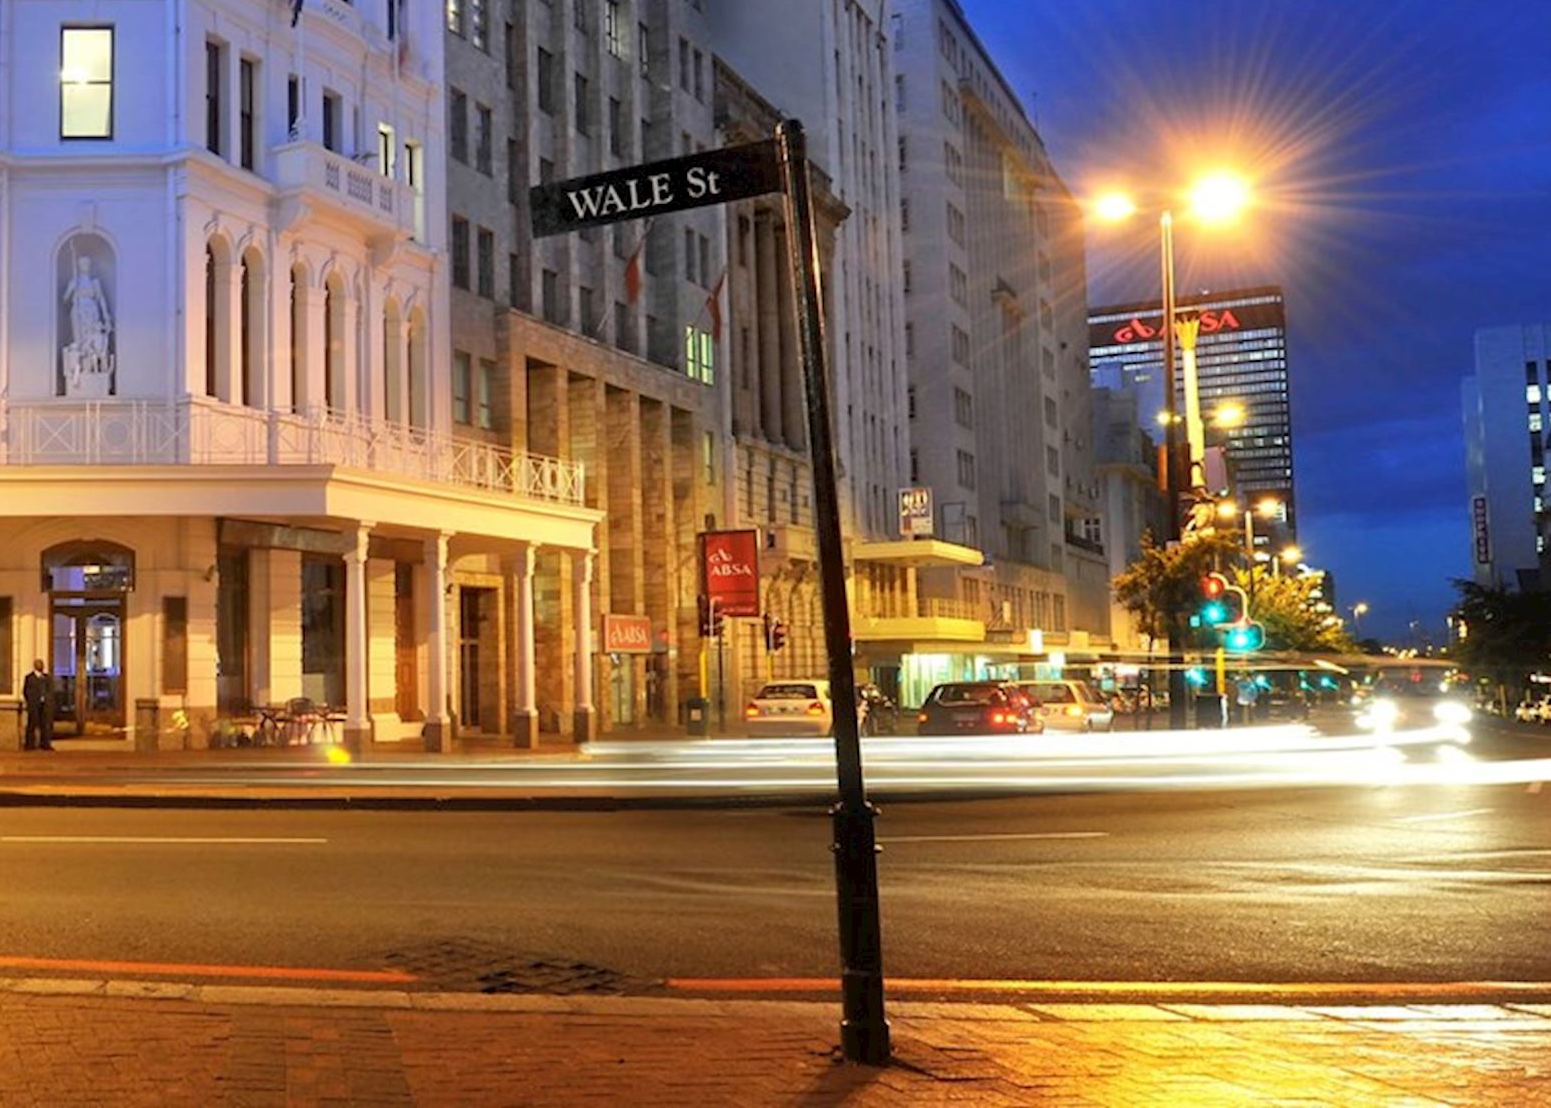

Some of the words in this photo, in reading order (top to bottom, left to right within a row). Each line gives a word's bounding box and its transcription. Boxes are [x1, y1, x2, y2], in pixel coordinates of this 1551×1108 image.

[567, 173, 674, 219] WALE
[687, 167, 721, 198] St
[711, 563, 752, 577] ABSA
